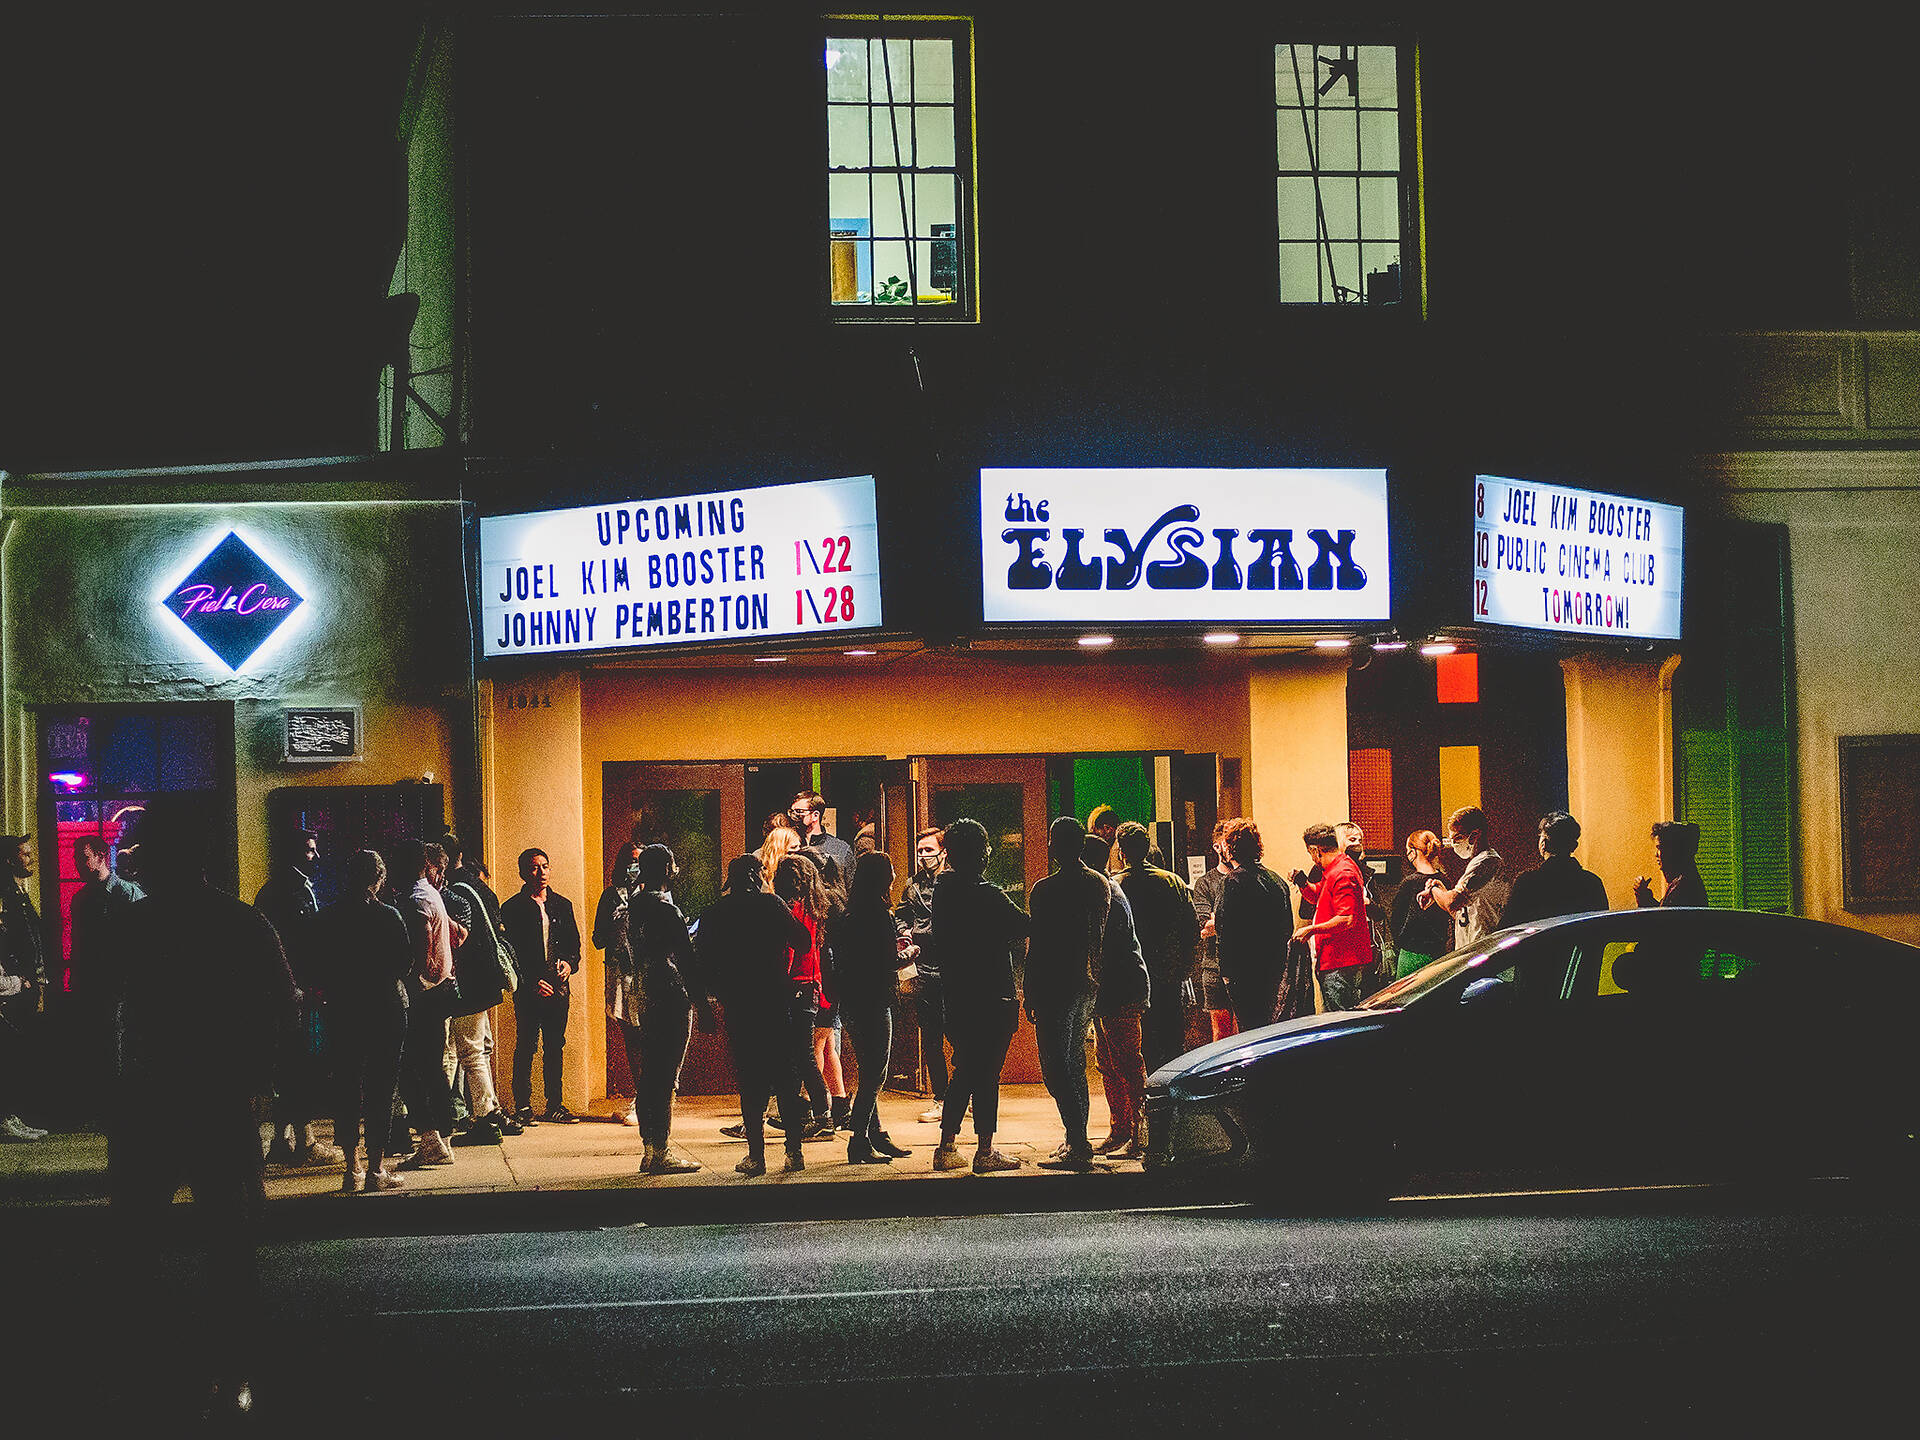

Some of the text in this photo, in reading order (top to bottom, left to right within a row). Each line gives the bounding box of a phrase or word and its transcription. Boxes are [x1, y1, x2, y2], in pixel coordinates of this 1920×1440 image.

[596, 497, 745, 547] UPCOMING
[1004, 492, 1050, 523] the
[1476, 482, 1654, 542] 8 JOEL KIM BOOSTER
[498, 562, 560, 603] JOEL
[581, 556, 630, 596] KIM
[647, 544, 765, 590] BOOSTER
[1000, 503, 1368, 591] ELYSIAN
[1476, 531, 1655, 587] 10 PUBLIC CINEMA CLUB
[178, 583, 233, 619] Piel
[496, 606, 597, 649] JOHNNY
[615, 592, 769, 640] PEMBERTON
[1475, 579, 1629, 630] 12 TOMORROW!
